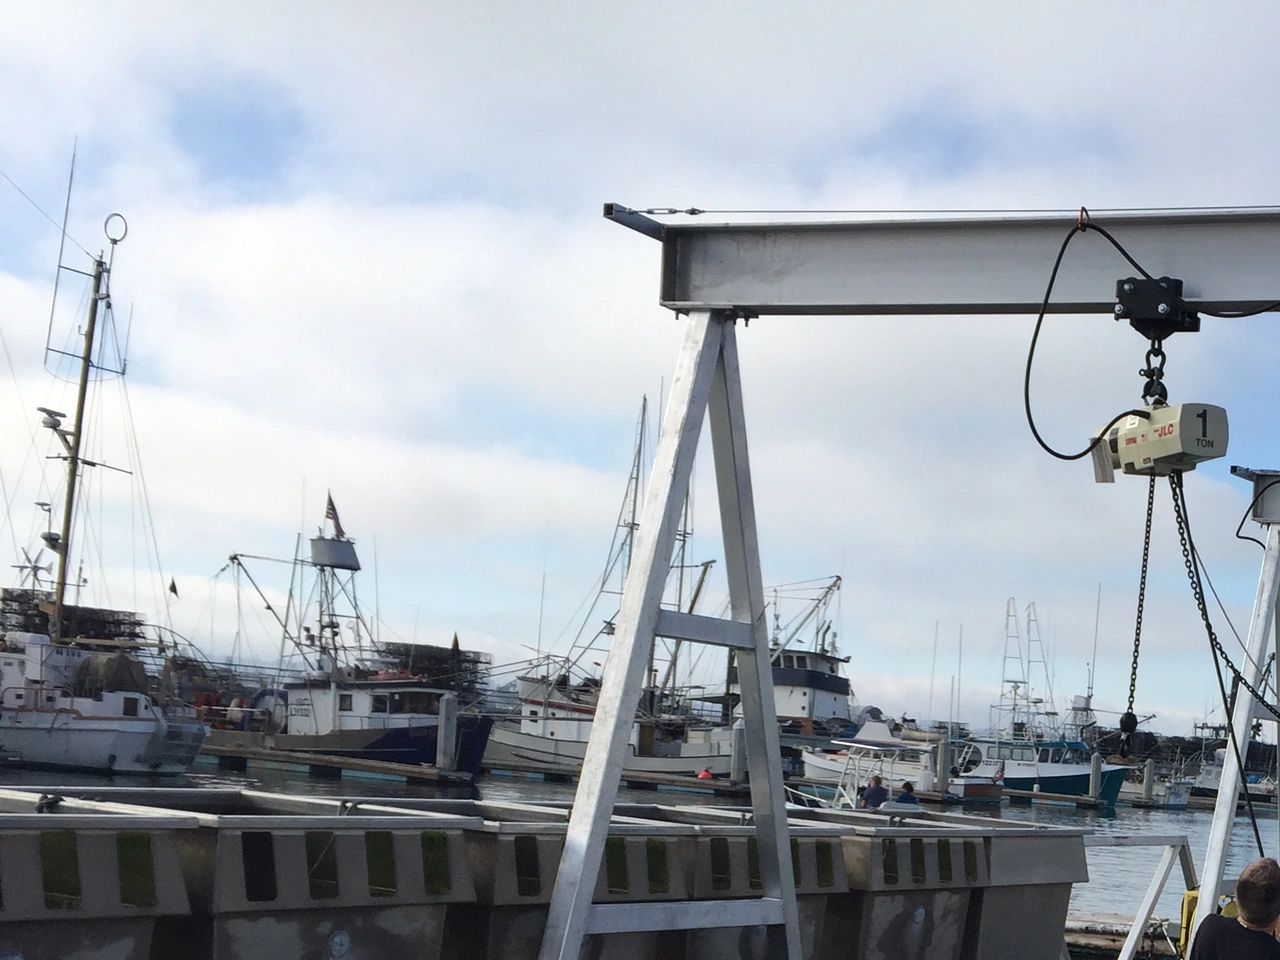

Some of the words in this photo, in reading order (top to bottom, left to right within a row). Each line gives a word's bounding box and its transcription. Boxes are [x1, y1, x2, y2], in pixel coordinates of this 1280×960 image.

[1158, 423, 1174, 438] JLC
[1196, 409, 1208, 438] 1
[1195, 438, 1214, 449] TON
